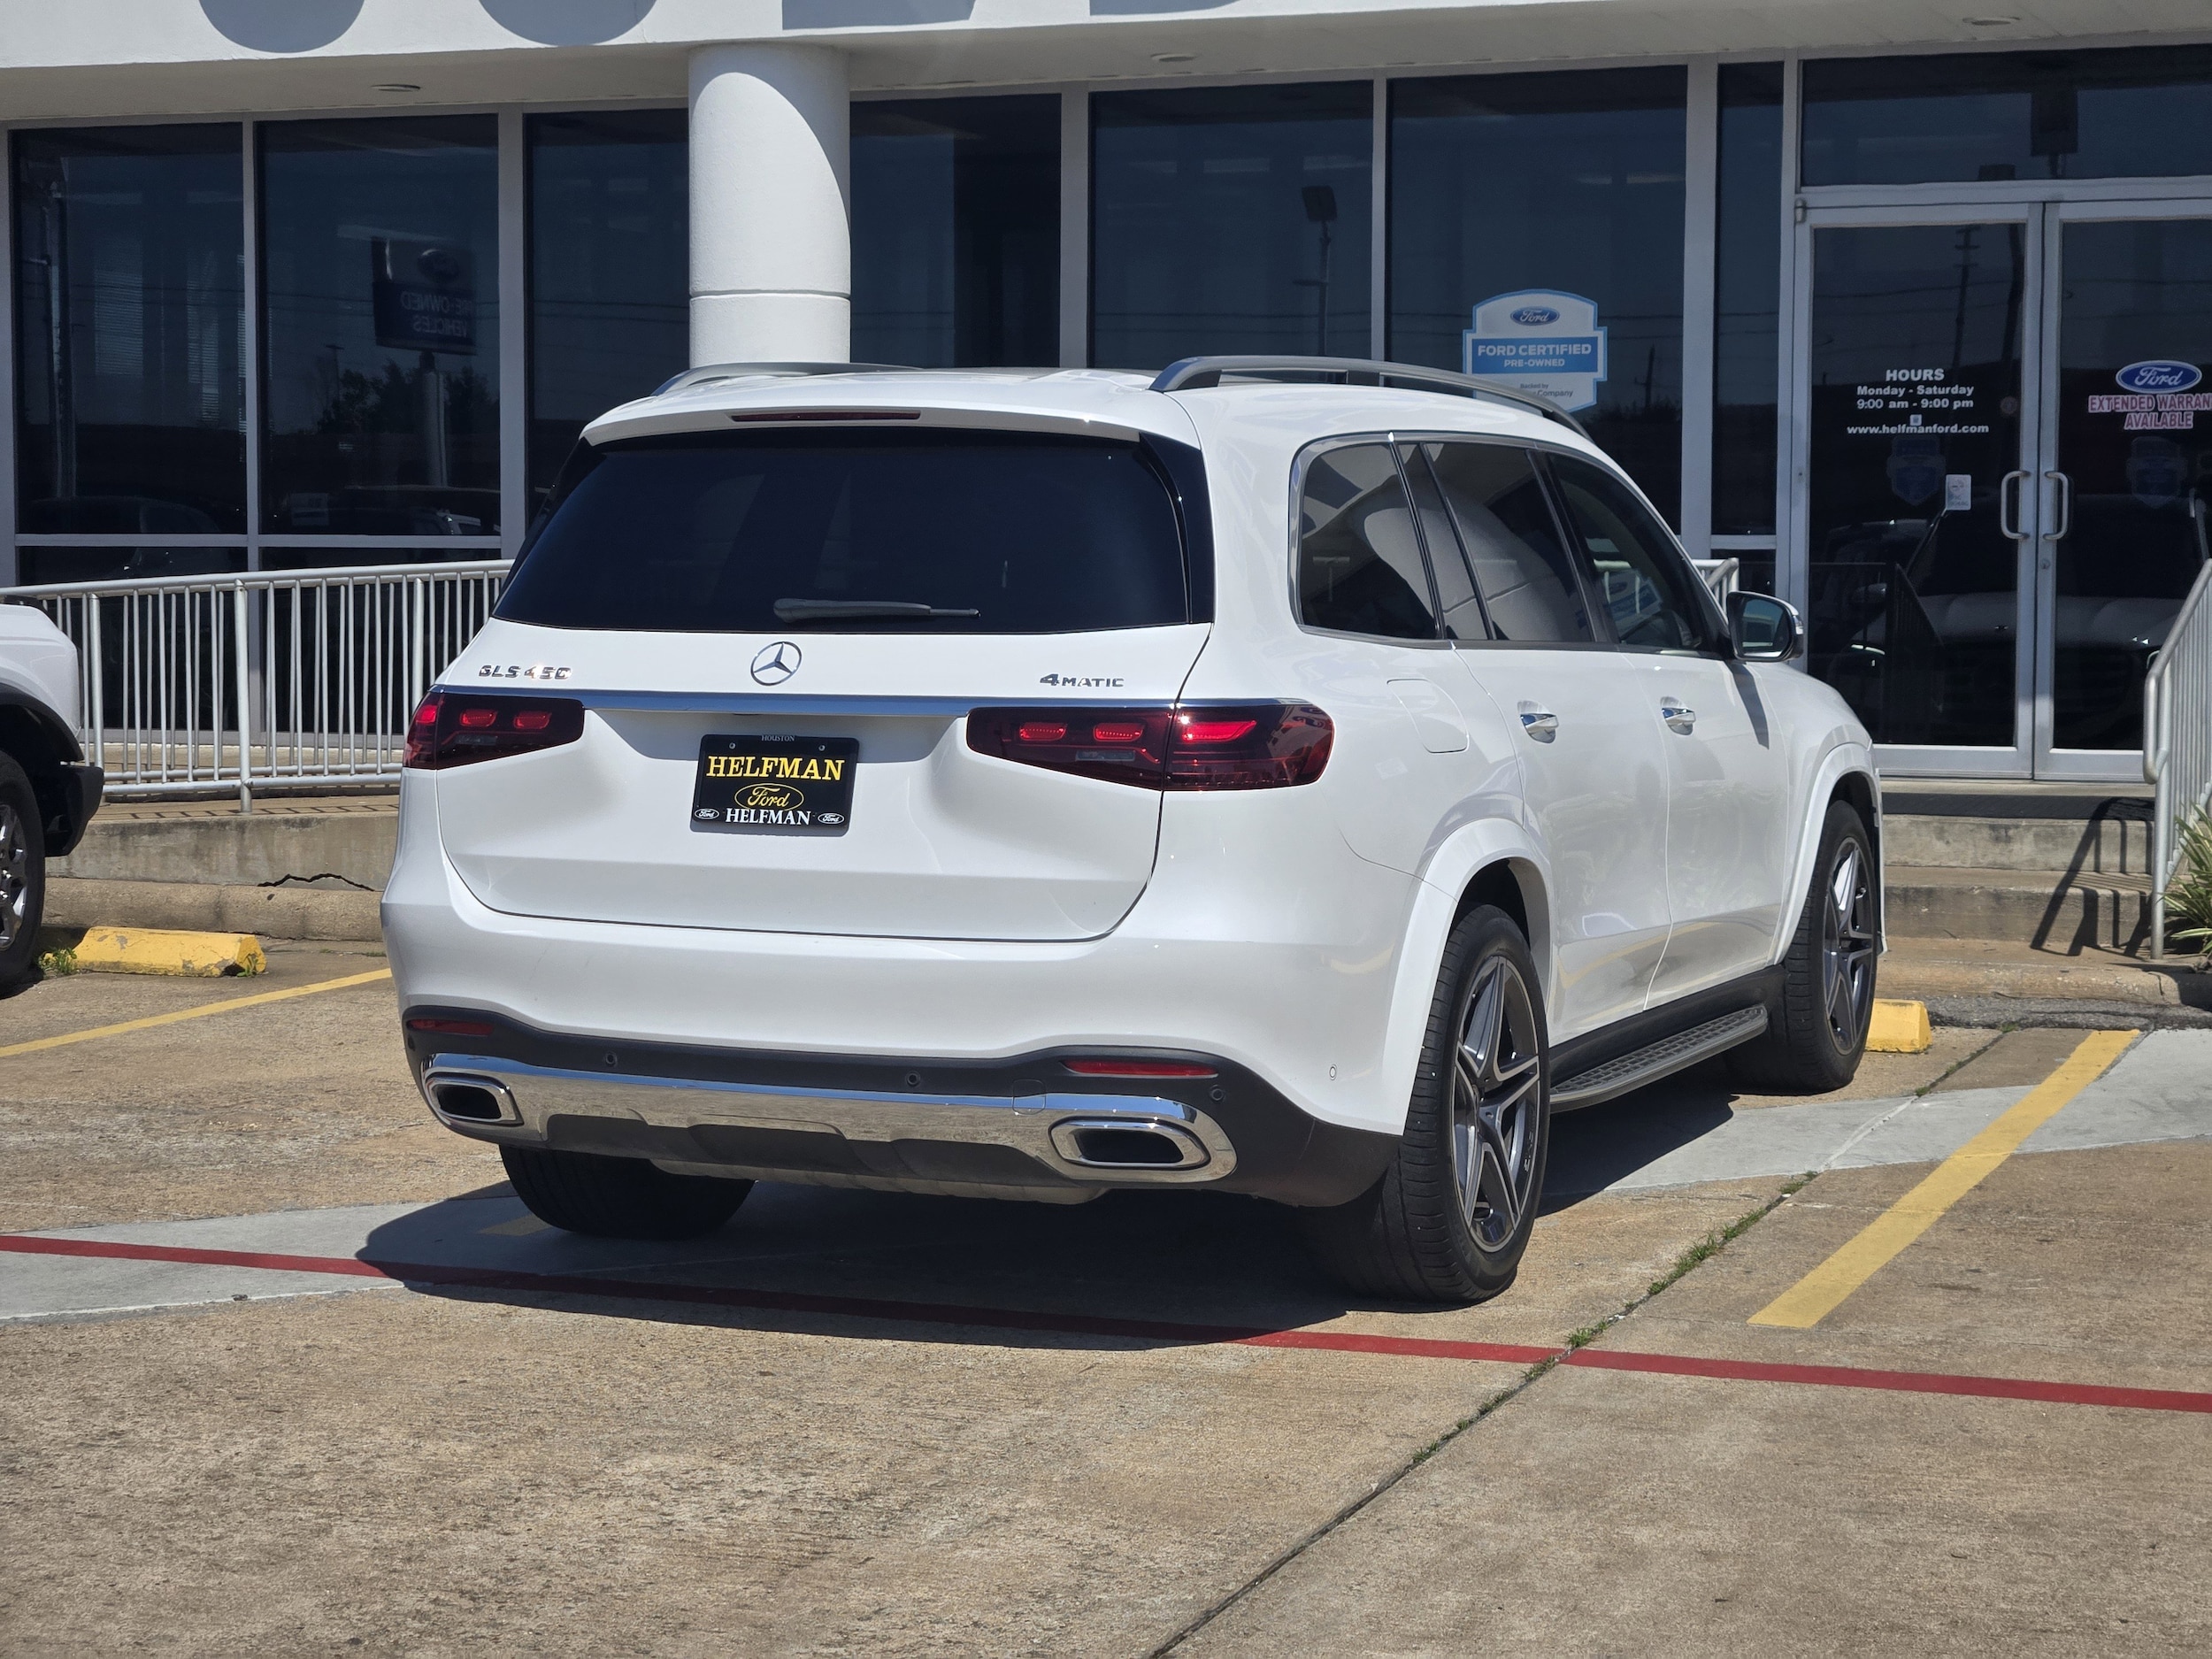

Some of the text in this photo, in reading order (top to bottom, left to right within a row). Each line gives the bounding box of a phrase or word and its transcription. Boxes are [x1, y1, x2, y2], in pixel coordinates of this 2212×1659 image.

[1478, 343, 1592, 357] FORD CERTIFIED
[1504, 358, 1565, 368] PRE-OWNED
[1886, 368, 1945, 381] HOURS
[1537, 389, 1573, 398] Company
[1857, 385, 1906, 397] Monday
[1916, 384, 1974, 396] Saturday
[1856, 398, 1884, 409] 9:00
[1888, 400, 1909, 409] am
[1920, 398, 1949, 408] 9:00
[1953, 399, 1974, 410] pm
[2088, 395, 2155, 413] EXTENDED
[2124, 411, 2193, 430] AVAILABLE
[1847, 423, 1989, 434] www.helfmanford.com
[479, 664, 572, 680] GLS 450
[1040, 673, 1125, 687] 4MATIC
[706, 756, 845, 781] HELFMAN
[747, 786, 790, 807] Ford
[725, 808, 811, 826] HELFMAN
